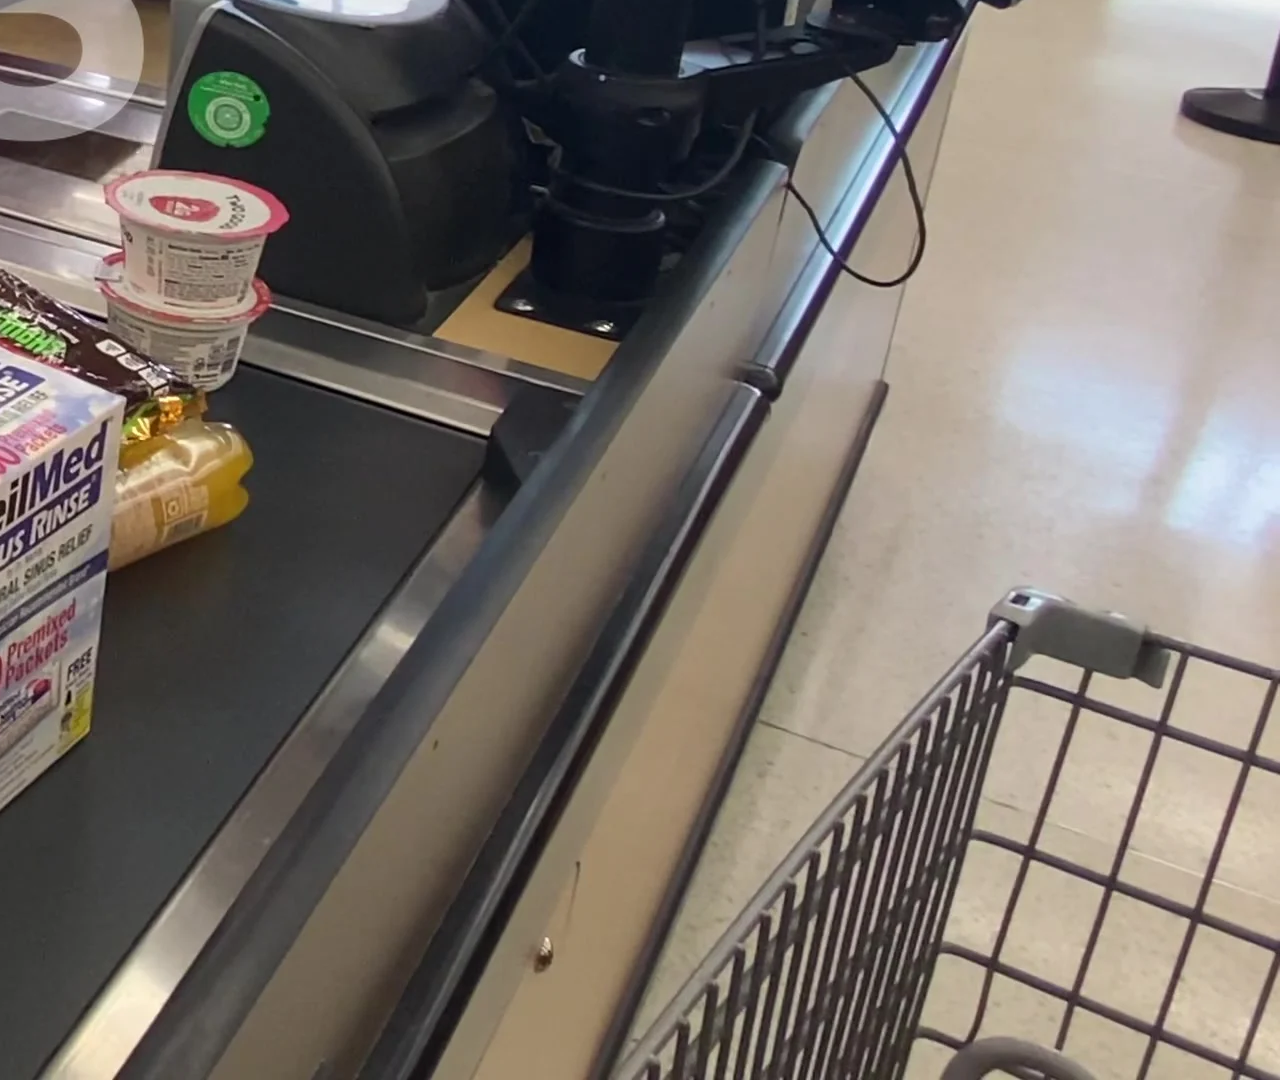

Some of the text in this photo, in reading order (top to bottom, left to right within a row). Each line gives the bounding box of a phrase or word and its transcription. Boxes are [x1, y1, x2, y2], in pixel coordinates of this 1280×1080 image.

[30, 484, 91, 545] RINSE
[23, 552, 55, 588] SINUS
[58, 524, 93, 559] RELIEF
[5, 629, 68, 688] Packets
[6, 599, 76, 661] Premixed
[67, 648, 93, 680] FREE
